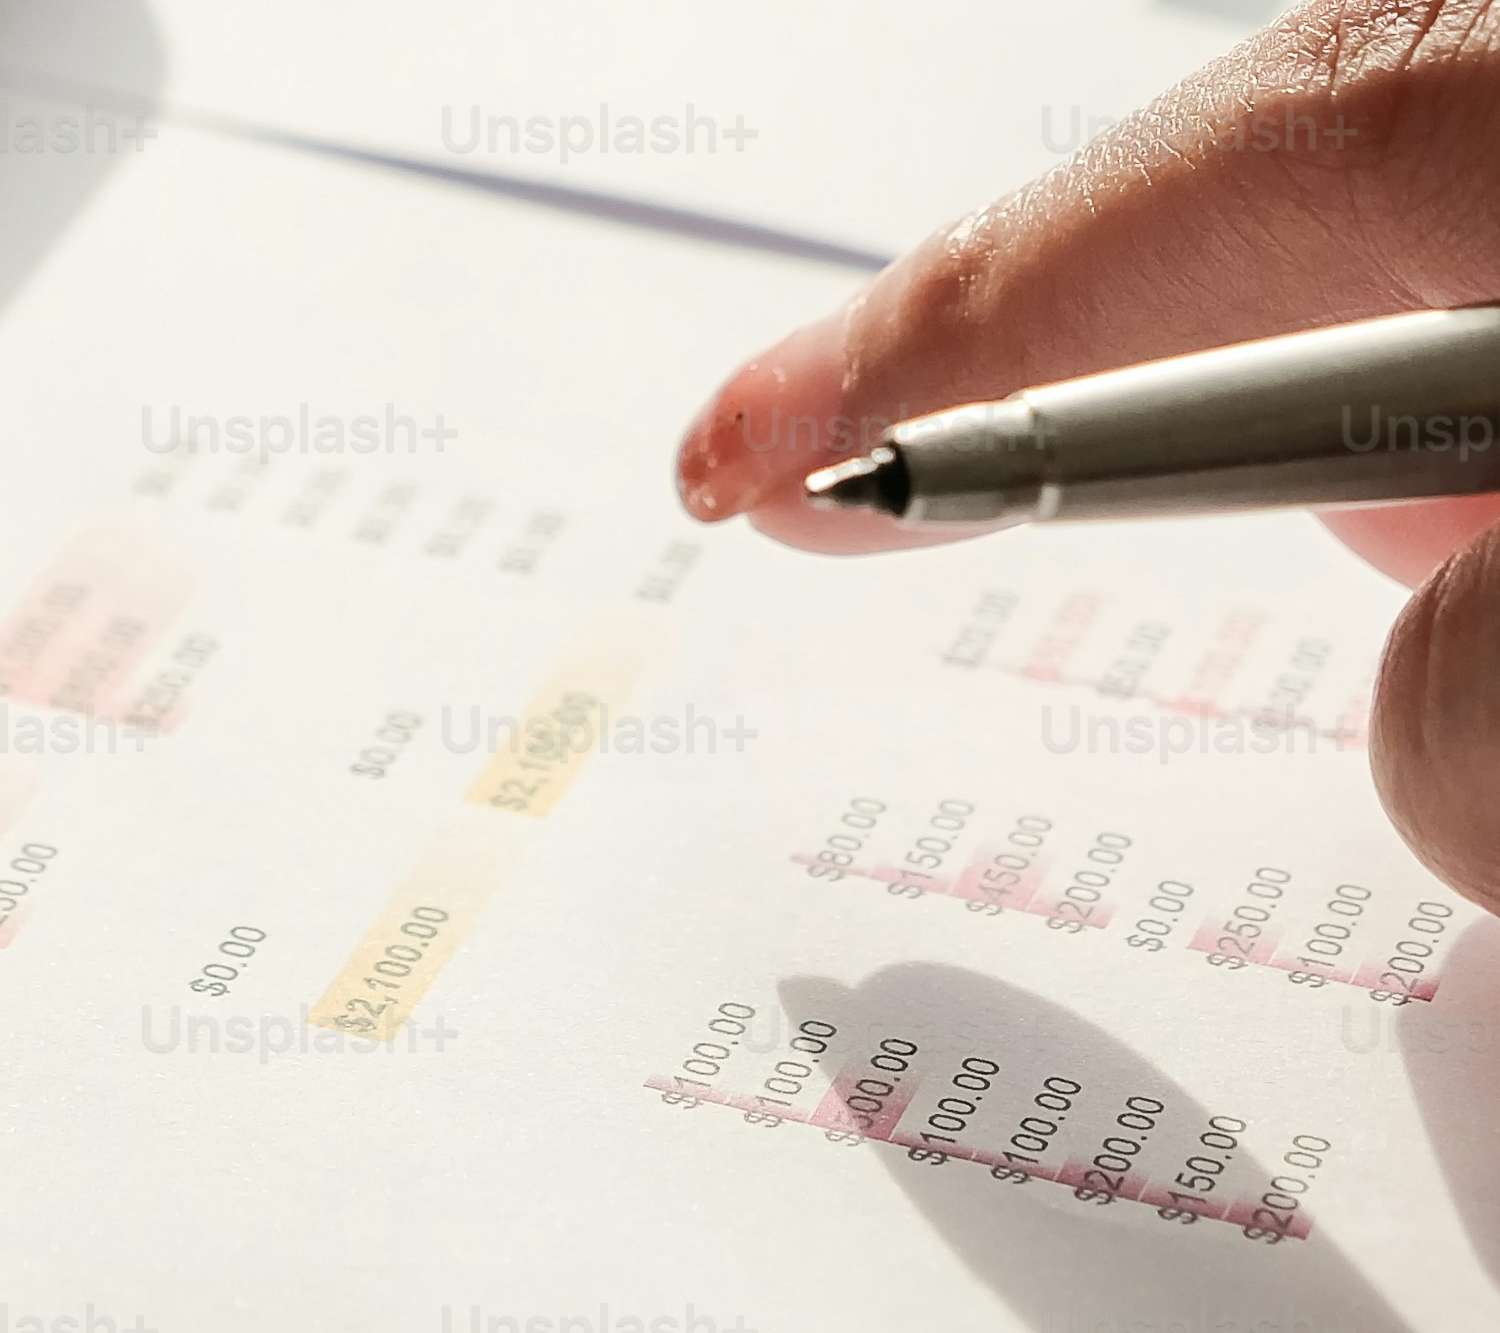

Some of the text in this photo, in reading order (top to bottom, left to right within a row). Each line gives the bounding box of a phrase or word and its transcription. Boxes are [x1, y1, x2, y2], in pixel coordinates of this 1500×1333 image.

[350, 711, 424, 779] $0.00
[807, 796, 887, 883] $80.00
[888, 798, 975, 900] $150.00
[966, 815, 1053, 916] $450.00
[1046, 832, 1133, 934] $200.00
[189, 926, 266, 997] $0.00
[1125, 877, 1194, 952] $0.00
[1206, 865, 1292, 971] $250.00
[1288, 883, 1372, 989] $100.00
[1369, 900, 1453, 1007] $200.00
[333, 906, 449, 1034] $2,100.00
[661, 1001, 757, 1110] $100.00
[743, 1019, 838, 1129] $100.00
[906, 1056, 1000, 1167] $100.00
[989, 1076, 1083, 1185] $100.00
[1072, 1095, 1166, 1206] $200.00
[1156, 1114, 1248, 1225] $150.00
[1242, 1133, 1333, 1244] $200.00
